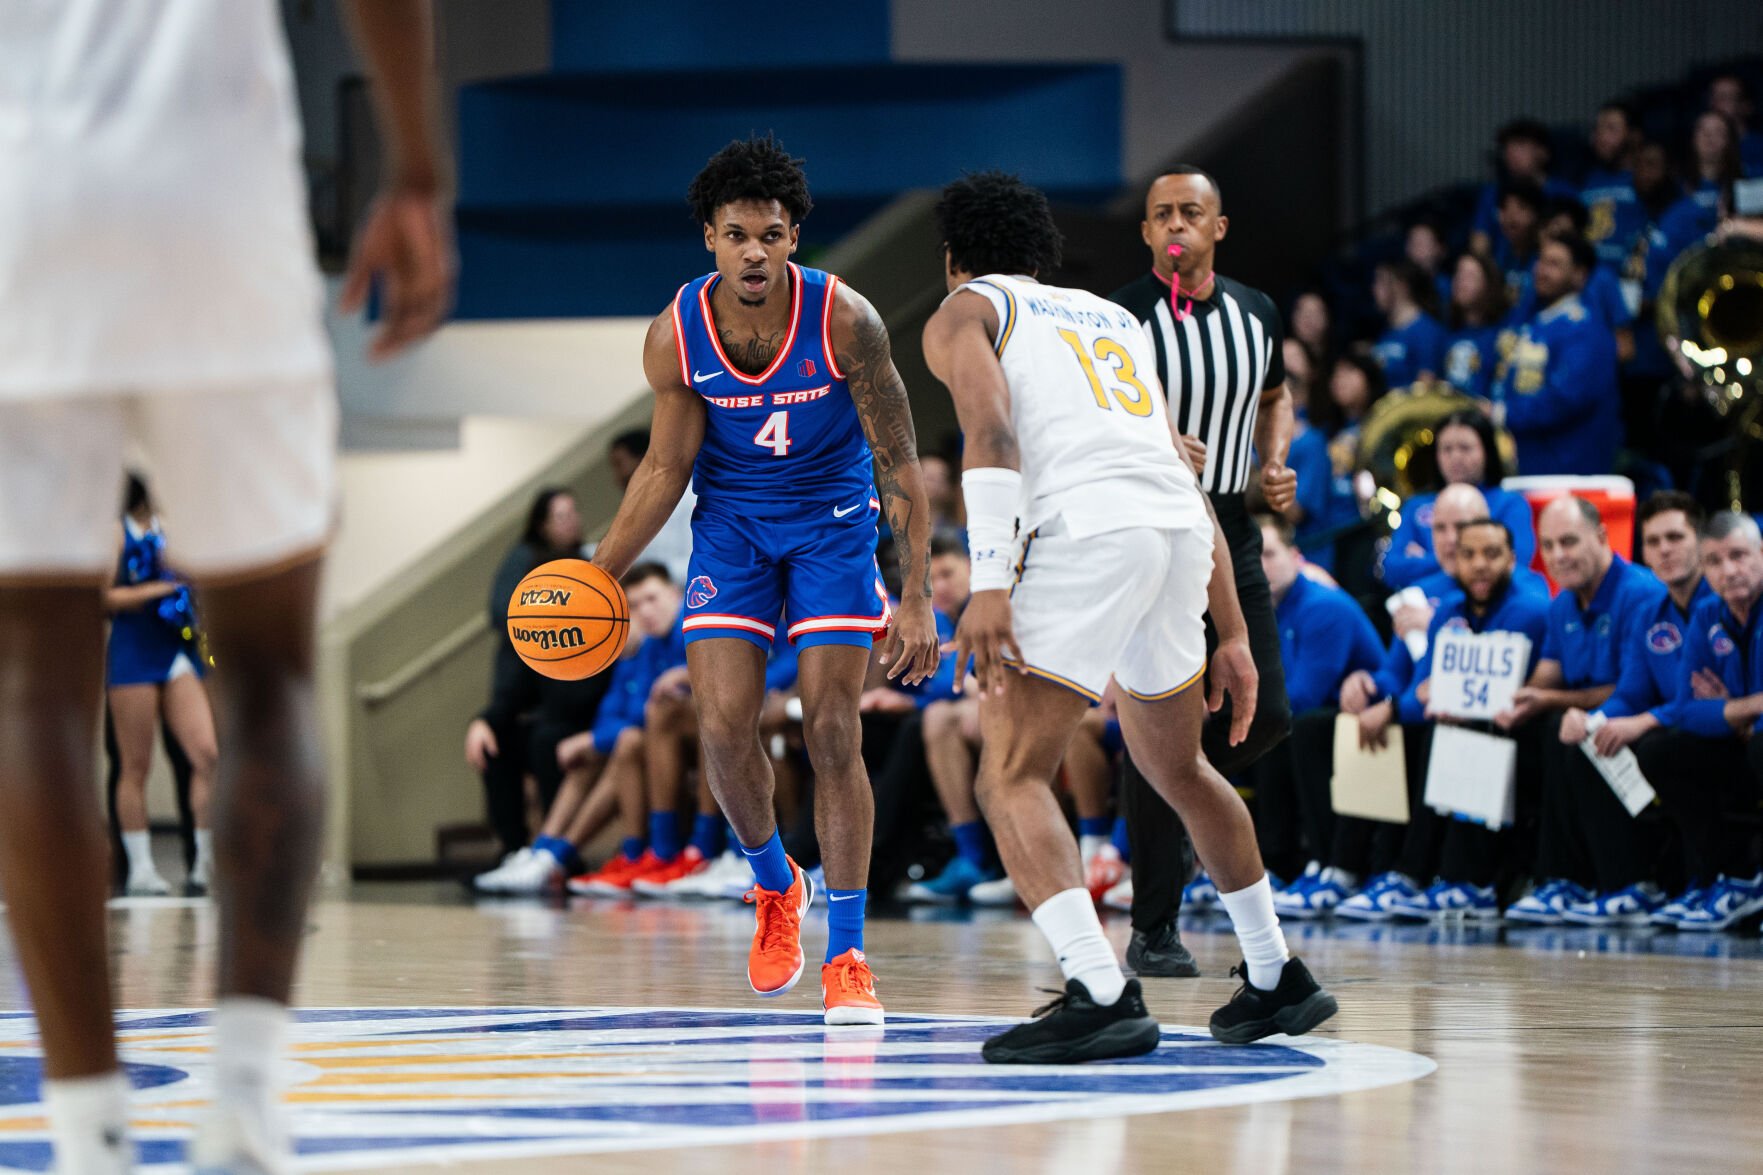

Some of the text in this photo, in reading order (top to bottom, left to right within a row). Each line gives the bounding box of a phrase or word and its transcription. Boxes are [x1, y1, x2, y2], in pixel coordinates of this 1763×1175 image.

[1056, 326, 1153, 417] 13
[770, 384, 831, 405] STATE
[754, 410, 792, 456] 4
[519, 589, 571, 606] NCAA
[512, 625, 586, 649] Wilson
[1442, 642, 1514, 677] BULLS
[1462, 679, 1489, 708] 54
